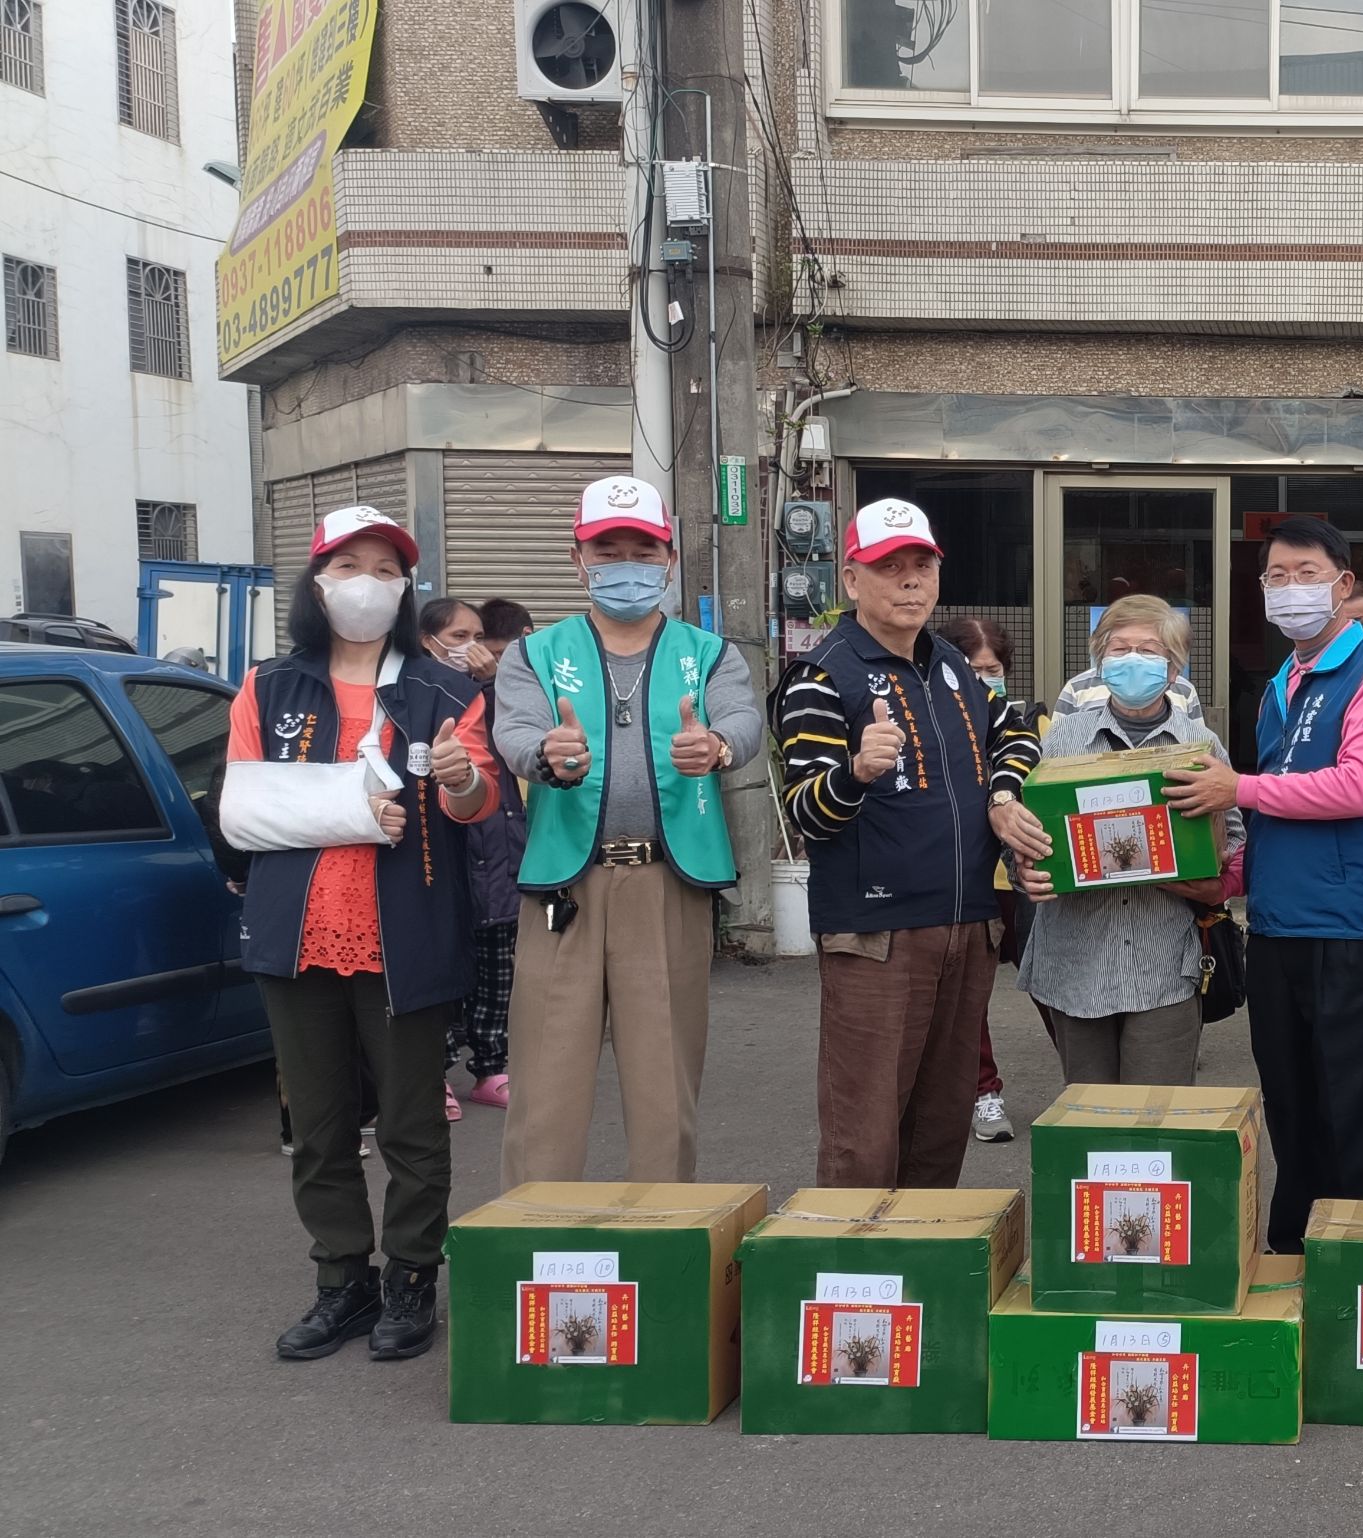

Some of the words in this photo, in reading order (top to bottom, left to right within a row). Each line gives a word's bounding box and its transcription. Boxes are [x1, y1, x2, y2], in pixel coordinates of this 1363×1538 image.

[222, 185, 332, 308] 0937-118806
[223, 243, 333, 354] 03-4899777
[730, 466, 740, 515] 0311032
[800, 634, 825, 650] 44
[551, 658, 584, 693] 志
[540, 1262, 585, 1276] 1月13日
[1102, 1334, 1150, 1347] 1月13日
